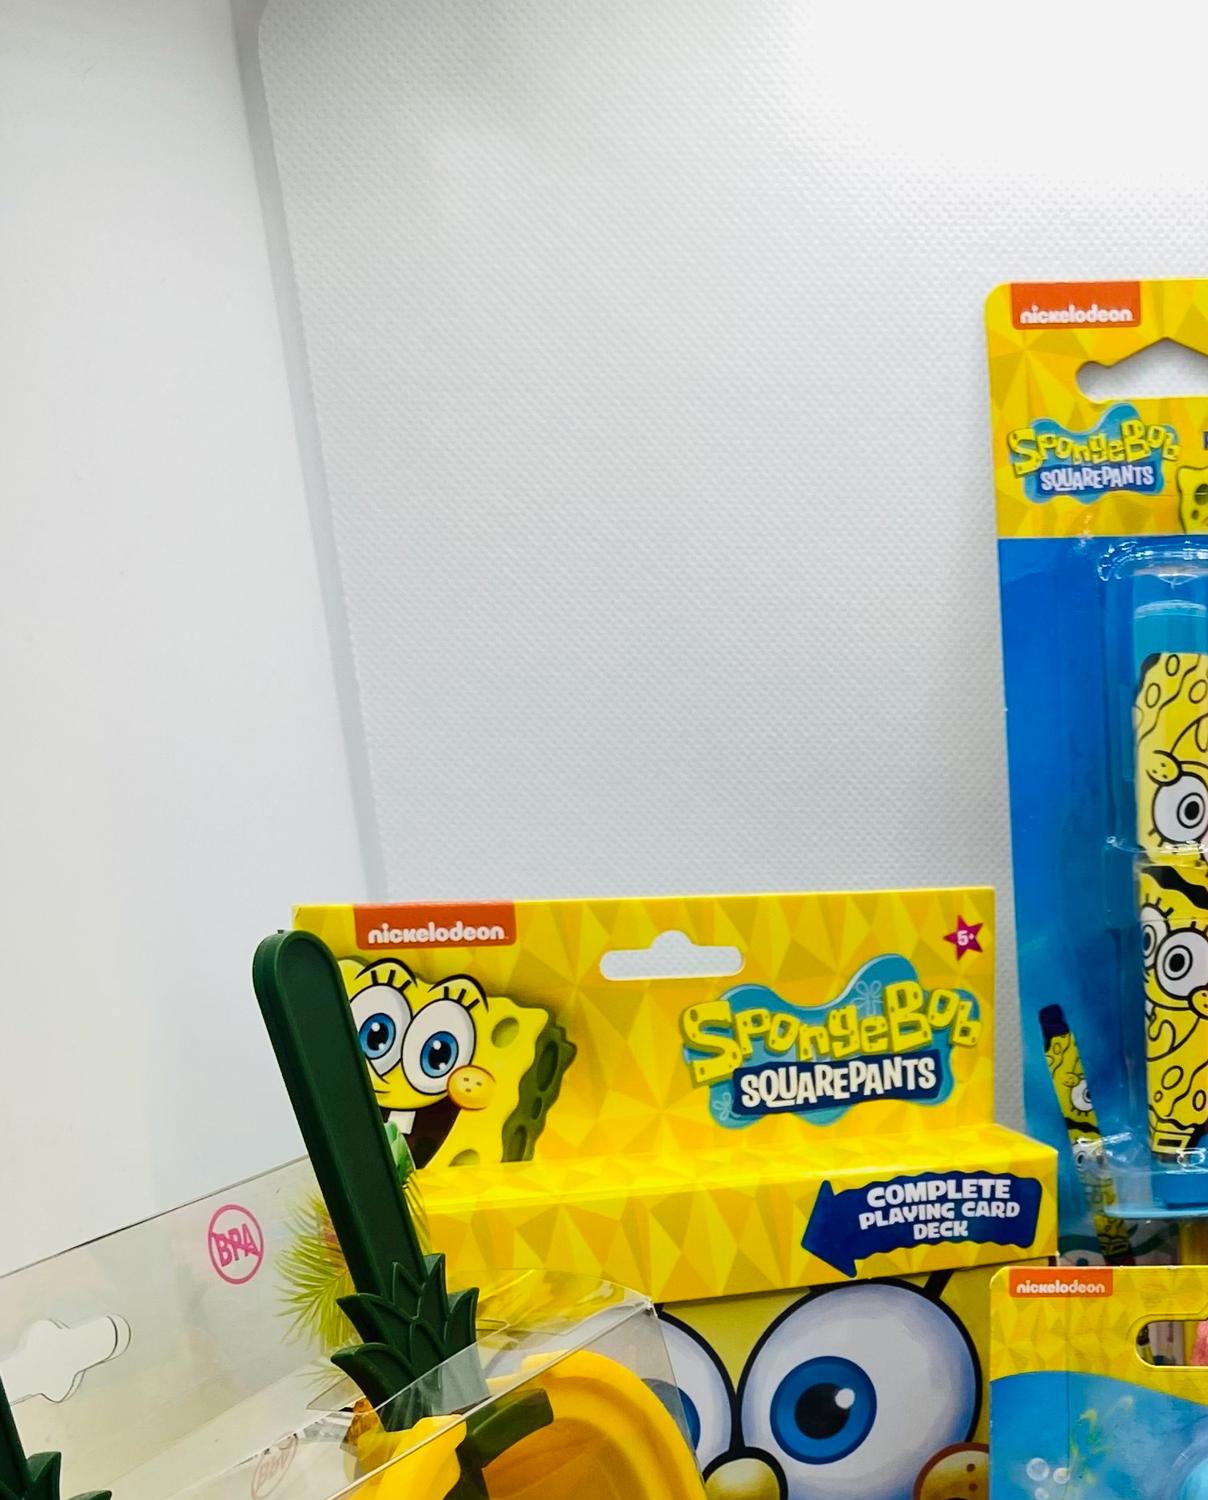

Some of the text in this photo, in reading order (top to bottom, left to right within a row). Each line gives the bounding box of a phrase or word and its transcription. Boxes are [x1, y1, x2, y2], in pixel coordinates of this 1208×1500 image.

[1020, 305, 1133, 325] nickelodeon
[1008, 420, 1179, 478] SpongeBob
[1040, 465, 1154, 492] SQUAREPANTS
[367, 921, 505, 945] nickelodeon
[955, 927, 976, 947] 5+
[680, 981, 981, 1086] SpongeBob
[741, 1056, 937, 1109] SQUAREPANTS
[866, 1179, 1011, 1208] COMPLETE
[858, 1201, 1020, 1230] PLAYING CARD
[913, 1220, 968, 1240] DECK
[1016, 1280, 1105, 1295] nickelodeon
